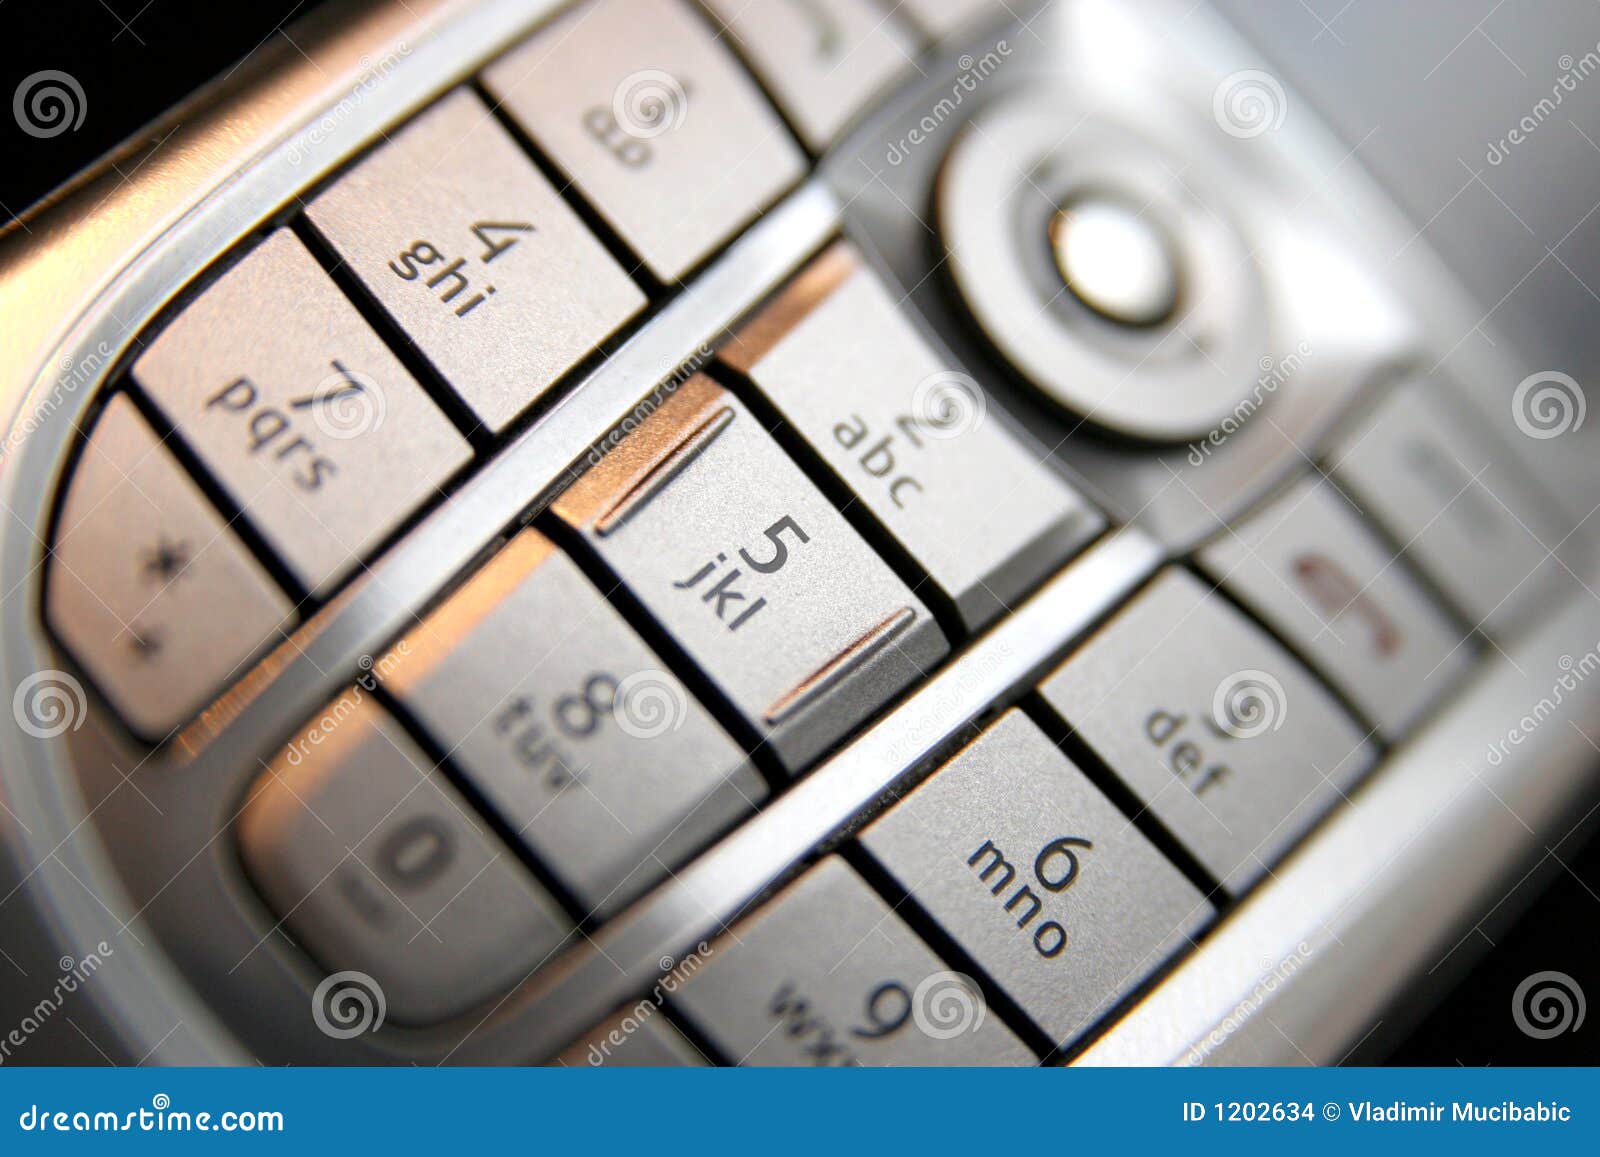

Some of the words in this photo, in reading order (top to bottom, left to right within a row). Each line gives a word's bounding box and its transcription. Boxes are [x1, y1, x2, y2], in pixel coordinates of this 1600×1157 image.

[388, 240, 496, 318] ghi
[469, 221, 537, 263] 4
[291, 359, 364, 409] 7
[206, 376, 338, 492] pqrs
[833, 412, 926, 510] abc
[739, 514, 811, 574] 5
[673, 551, 768, 632] jkl
[554, 673, 622, 739] 8
[1146, 710, 1235, 798] def
[378, 816, 458, 893] 0
[1034, 837, 1094, 893] 6
[967, 839, 1067, 958] mno
[852, 976, 913, 1039] 9
